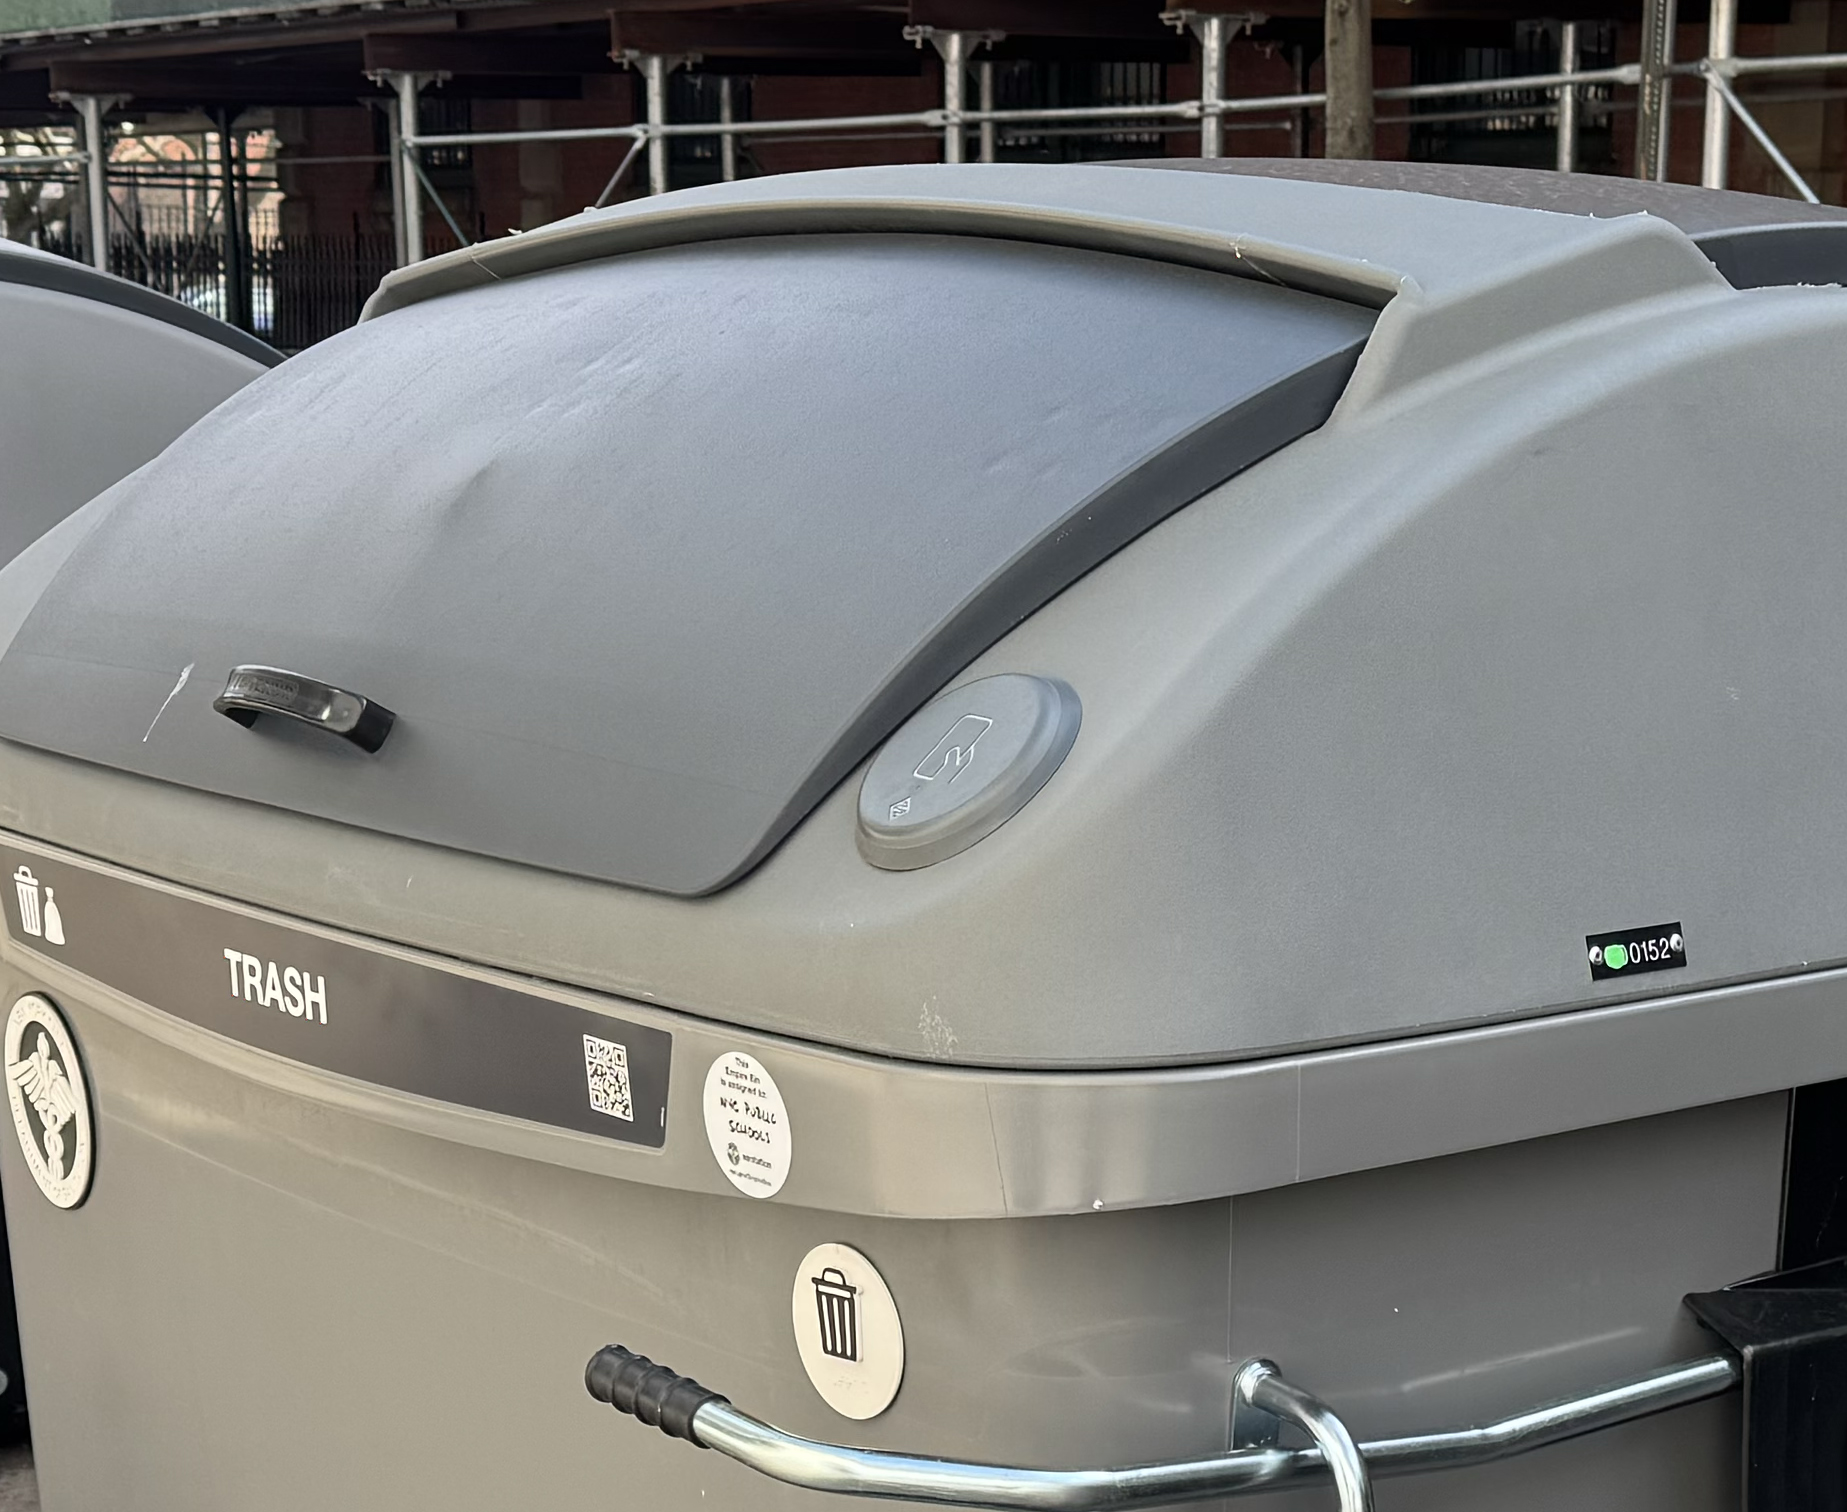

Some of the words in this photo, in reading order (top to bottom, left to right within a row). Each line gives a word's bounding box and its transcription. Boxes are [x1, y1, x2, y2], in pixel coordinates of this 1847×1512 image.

[223, 947, 328, 1025] TRASH
[744, 1101, 776, 1124] PUBLIC
[728, 1119, 770, 1143] SCHOOLS
